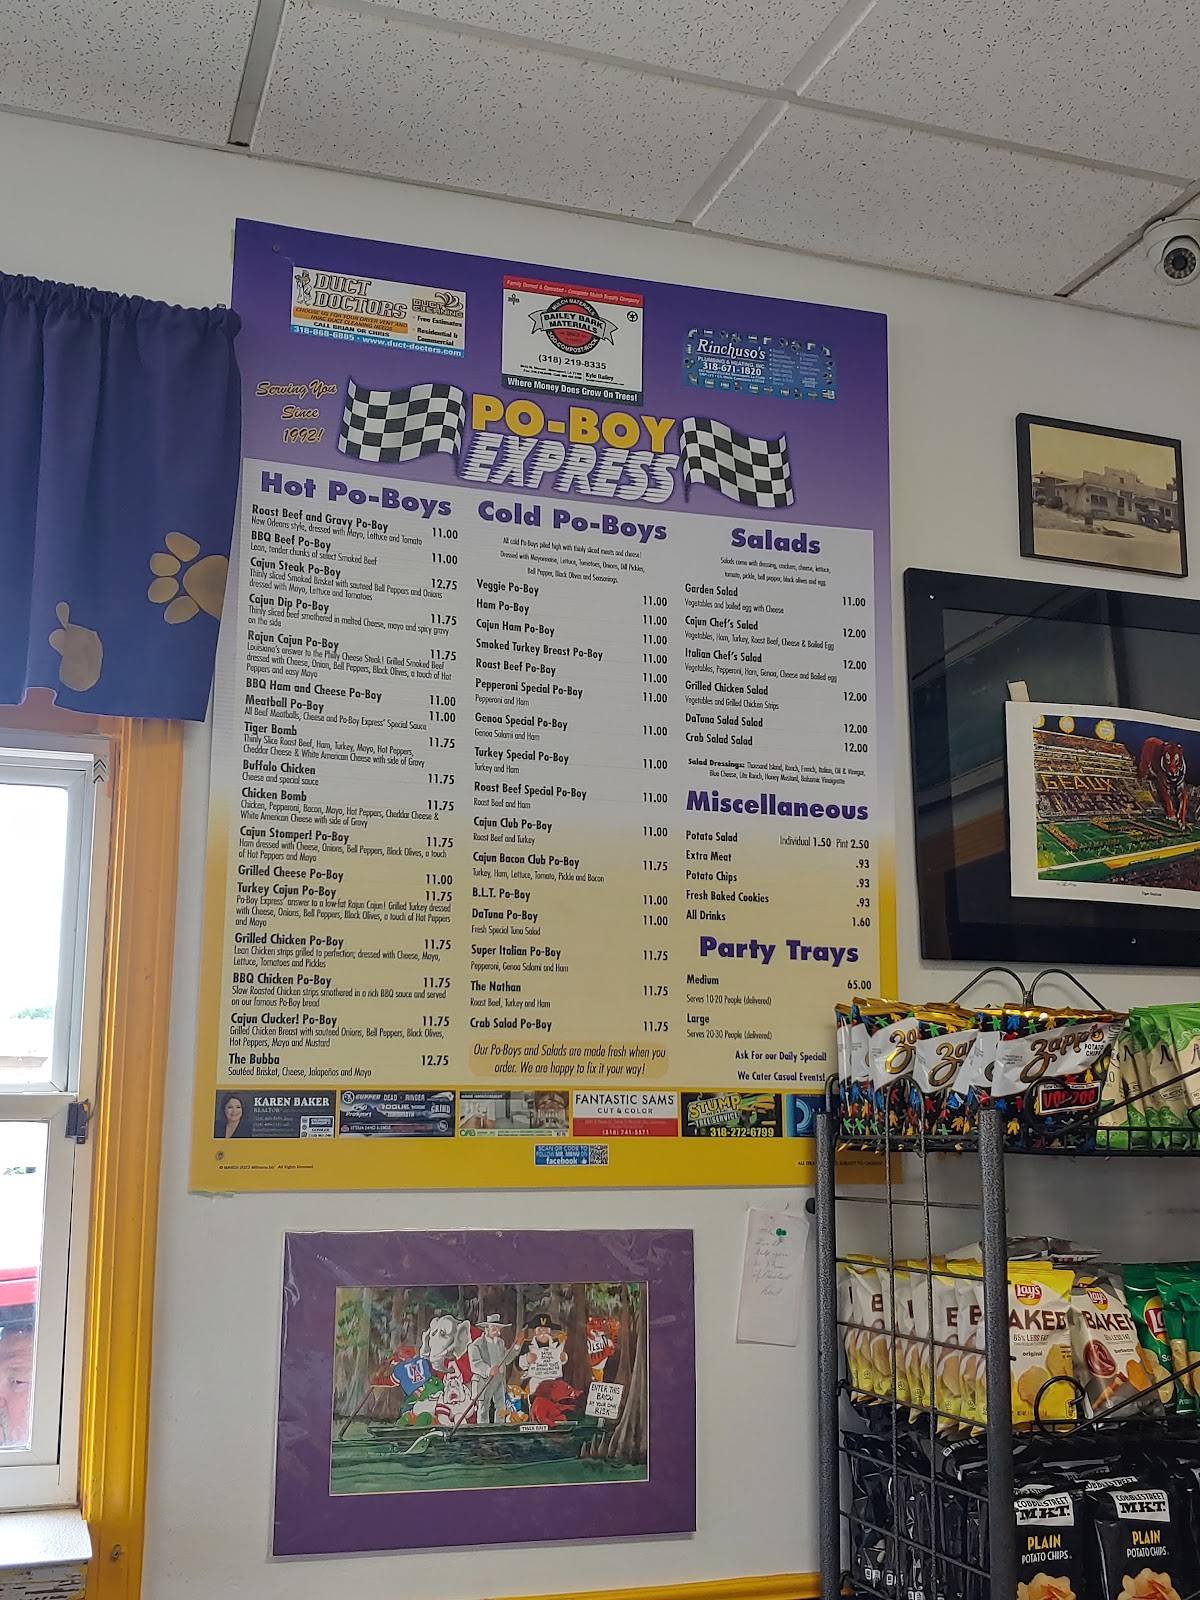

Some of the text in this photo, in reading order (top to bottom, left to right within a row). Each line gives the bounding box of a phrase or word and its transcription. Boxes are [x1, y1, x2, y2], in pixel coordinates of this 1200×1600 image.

[314, 273, 372, 296] DUCT
[312, 291, 408, 320] DOCTORS
[432, 317, 462, 327] Estimates
[544, 312, 604, 328] BAILEY BARK
[550, 321, 598, 334] MATERIALS
[417, 328, 452, 338] Residential
[417, 336, 454, 346] Commercial
[362, 337, 462, 357] www.duct-doctors.com
[696, 338, 766, 360] Rinchuso's
[538, 354, 607, 370] (318) 219-8335
[702, 362, 762, 376] 318-671-1820
[255, 379, 337, 398] Serving You
[508, 378, 638, 402] Where Money Does Grow On Trees!
[281, 404, 319, 420] Since
[471, 393, 676, 453] PO-BOY
[282, 428, 325, 444] 1992!
[459, 432, 681, 504] EXPRESS
[261, 471, 451, 519] Hot Po-Boys
[252, 504, 458, 539] Roast Beef and Gravy Po-Boy 11.00
[477, 500, 667, 543] Cold Po-Boys
[731, 527, 821, 555] Salads
[476, 578, 667, 606] Veggie Po-Boy 11.00
[684, 584, 866, 607] Garden Salad 11.00
[475, 638, 667, 664] Smoked Turkey Breast Po-Boy 11.00
[685, 648, 866, 670] Italian Chef's Salad 12.00
[245, 721, 455, 748] Tiger Bomb 11.75
[1042, 776, 1115, 794] GEAUX
[686, 790, 869, 820] Miscellaneous
[472, 851, 668, 871] Cajun Bacon Club Po-Boy 11.75
[686, 890, 870, 908] Fresh Baked Cookies .93
[686, 910, 870, 927] All Drinks 1.60
[234, 933, 451, 949] Grilled Chicken Po-Boy 11.75
[700, 936, 858, 967] Party Trays
[686, 974, 871, 990] Medium 65.00
[469, 1018, 668, 1031] Crab Salad Po-Boy 11.75
[229, 1053, 448, 1065] The Bubba 12.75
[473, 1043, 666, 1060] Our Po-Boys and Salads are made fresh when you
[735, 1051, 827, 1063] Ask For our Daily Special!
[254, 1097, 330, 1107] KAREN BAKER
[575, 1094, 674, 1105] FANTASTIC SAMS
[689, 1096, 741, 1118] STUMP
[710, 1127, 774, 1137] 318-272-6799
[546, 1156, 578, 1164] facebook
[1009, 1308, 1067, 1330] AKED
[1026, 1334, 1040, 1342] LESS
[591, 1384, 608, 1393] ENTER
[1019, 1506, 1070, 1520] MKT.
[1119, 1501, 1166, 1513] MKT.
[1027, 1534, 1061, 1551] PLAIN
[1131, 1529, 1161, 1545] PLAIN
[1022, 1550, 1069, 1564] POTATO CHIPS
[1127, 1546, 1167, 1558] POTATO CHIPS
